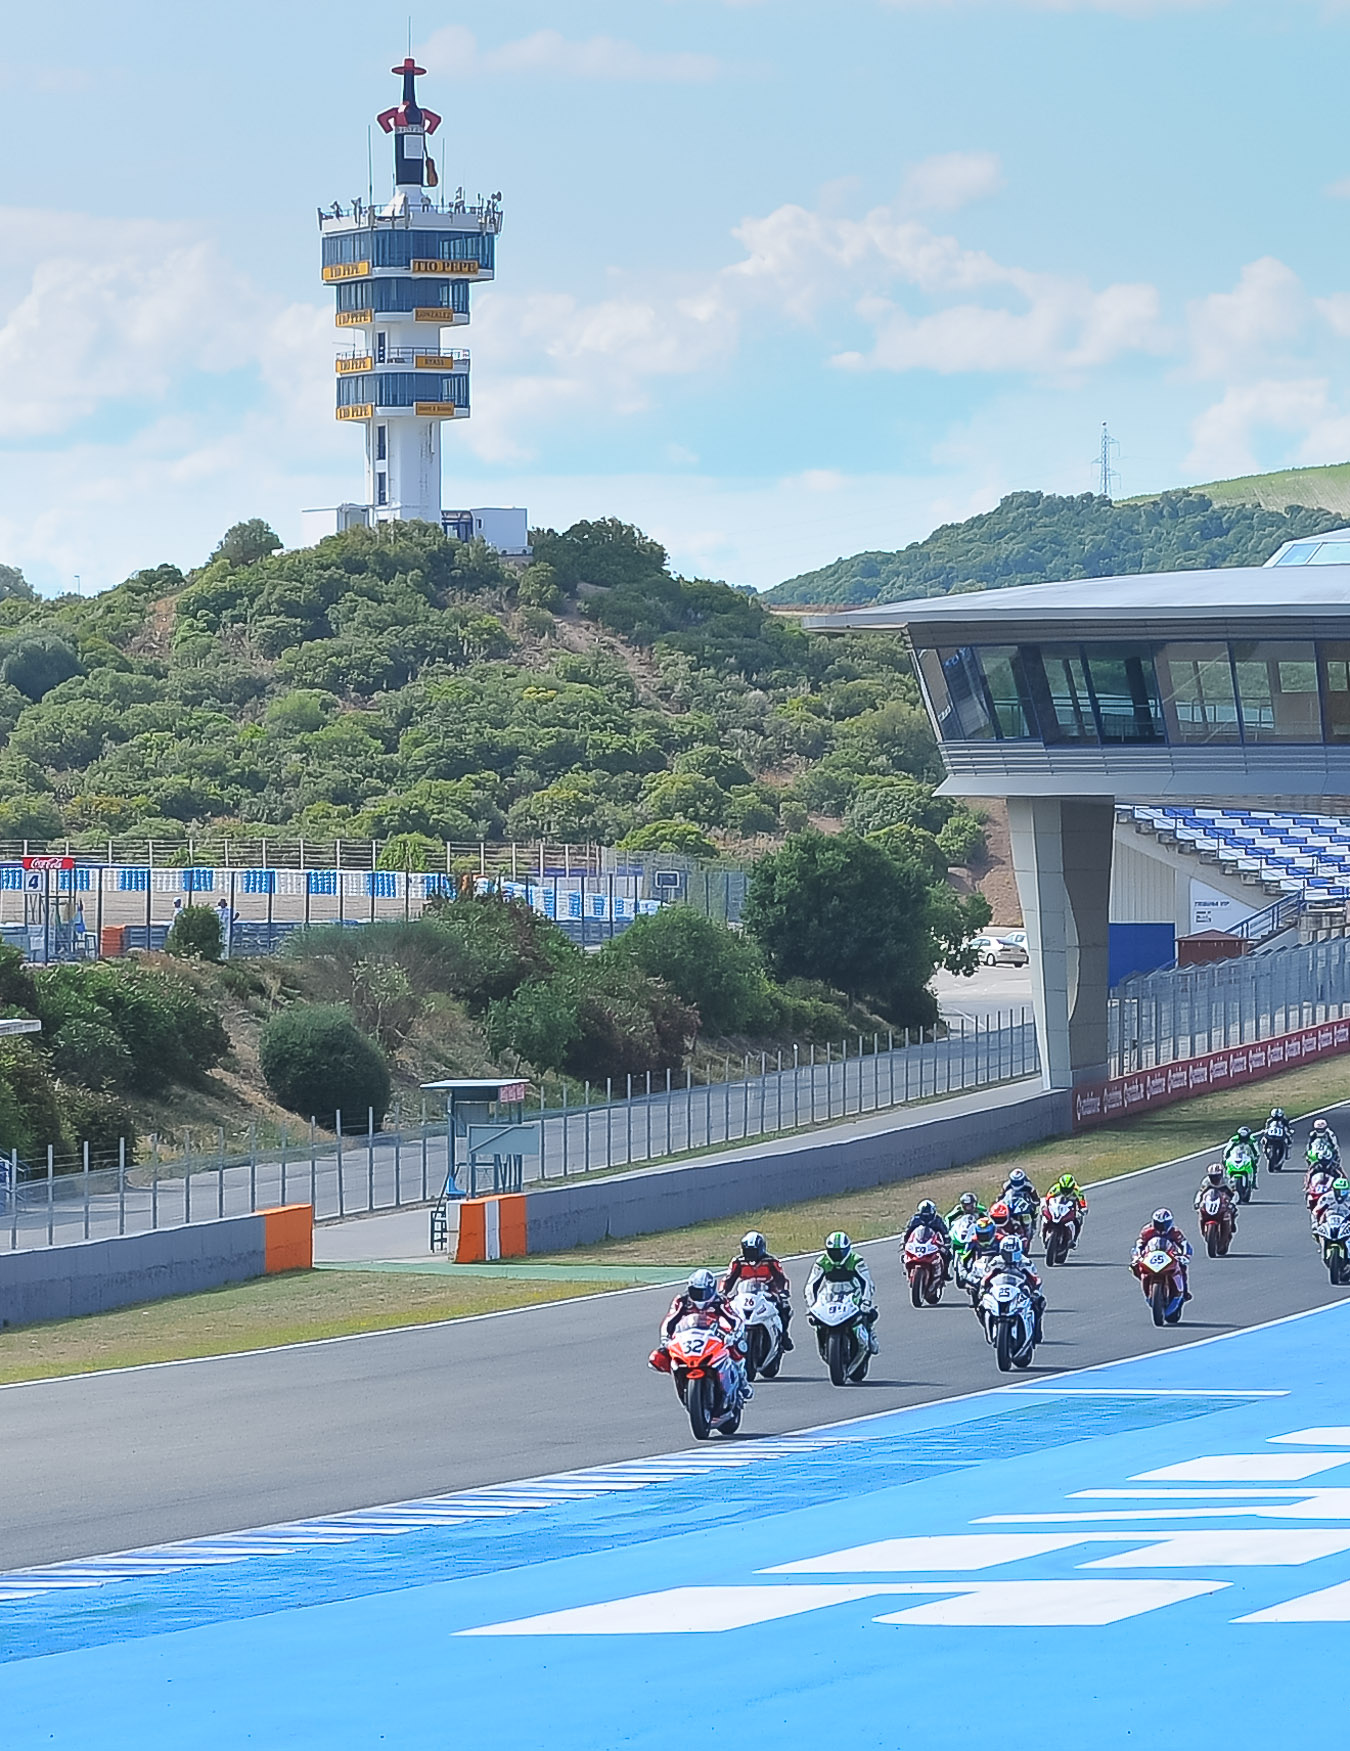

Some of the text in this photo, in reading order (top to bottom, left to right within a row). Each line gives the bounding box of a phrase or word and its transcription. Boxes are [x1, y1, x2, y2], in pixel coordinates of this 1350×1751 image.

[414, 261, 476, 273] TIO PEPE
[28, 875, 39, 889] 4
[683, 1339, 705, 1354] 32
